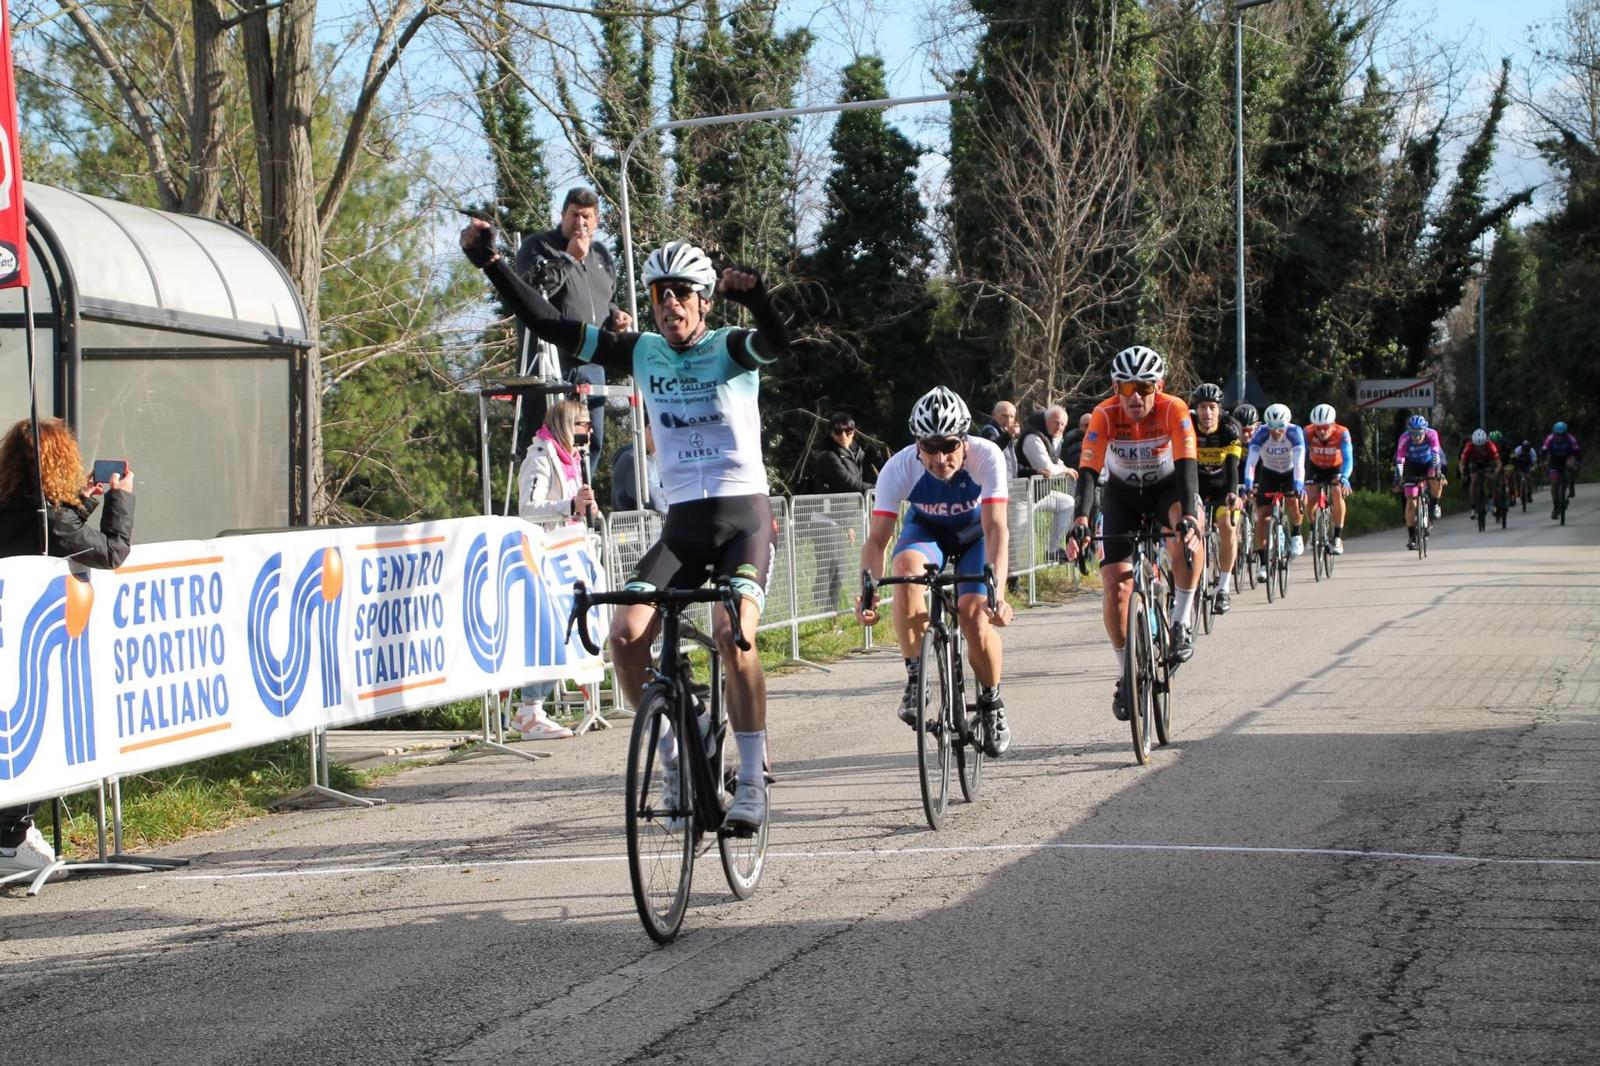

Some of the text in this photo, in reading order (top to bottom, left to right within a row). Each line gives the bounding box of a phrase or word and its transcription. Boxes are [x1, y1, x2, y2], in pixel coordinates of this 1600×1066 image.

[680, 380, 717, 391] GALLERY
[678, 448, 720, 459] ENERGY
[361, 549, 444, 595] CENTRO
[113, 571, 223, 628] CENTRO
[354, 592, 444, 642] SPORTIVO
[113, 623, 225, 684] SPORTIVO
[355, 635, 445, 687] ITALIANO
[117, 674, 229, 738] ITALIANO
